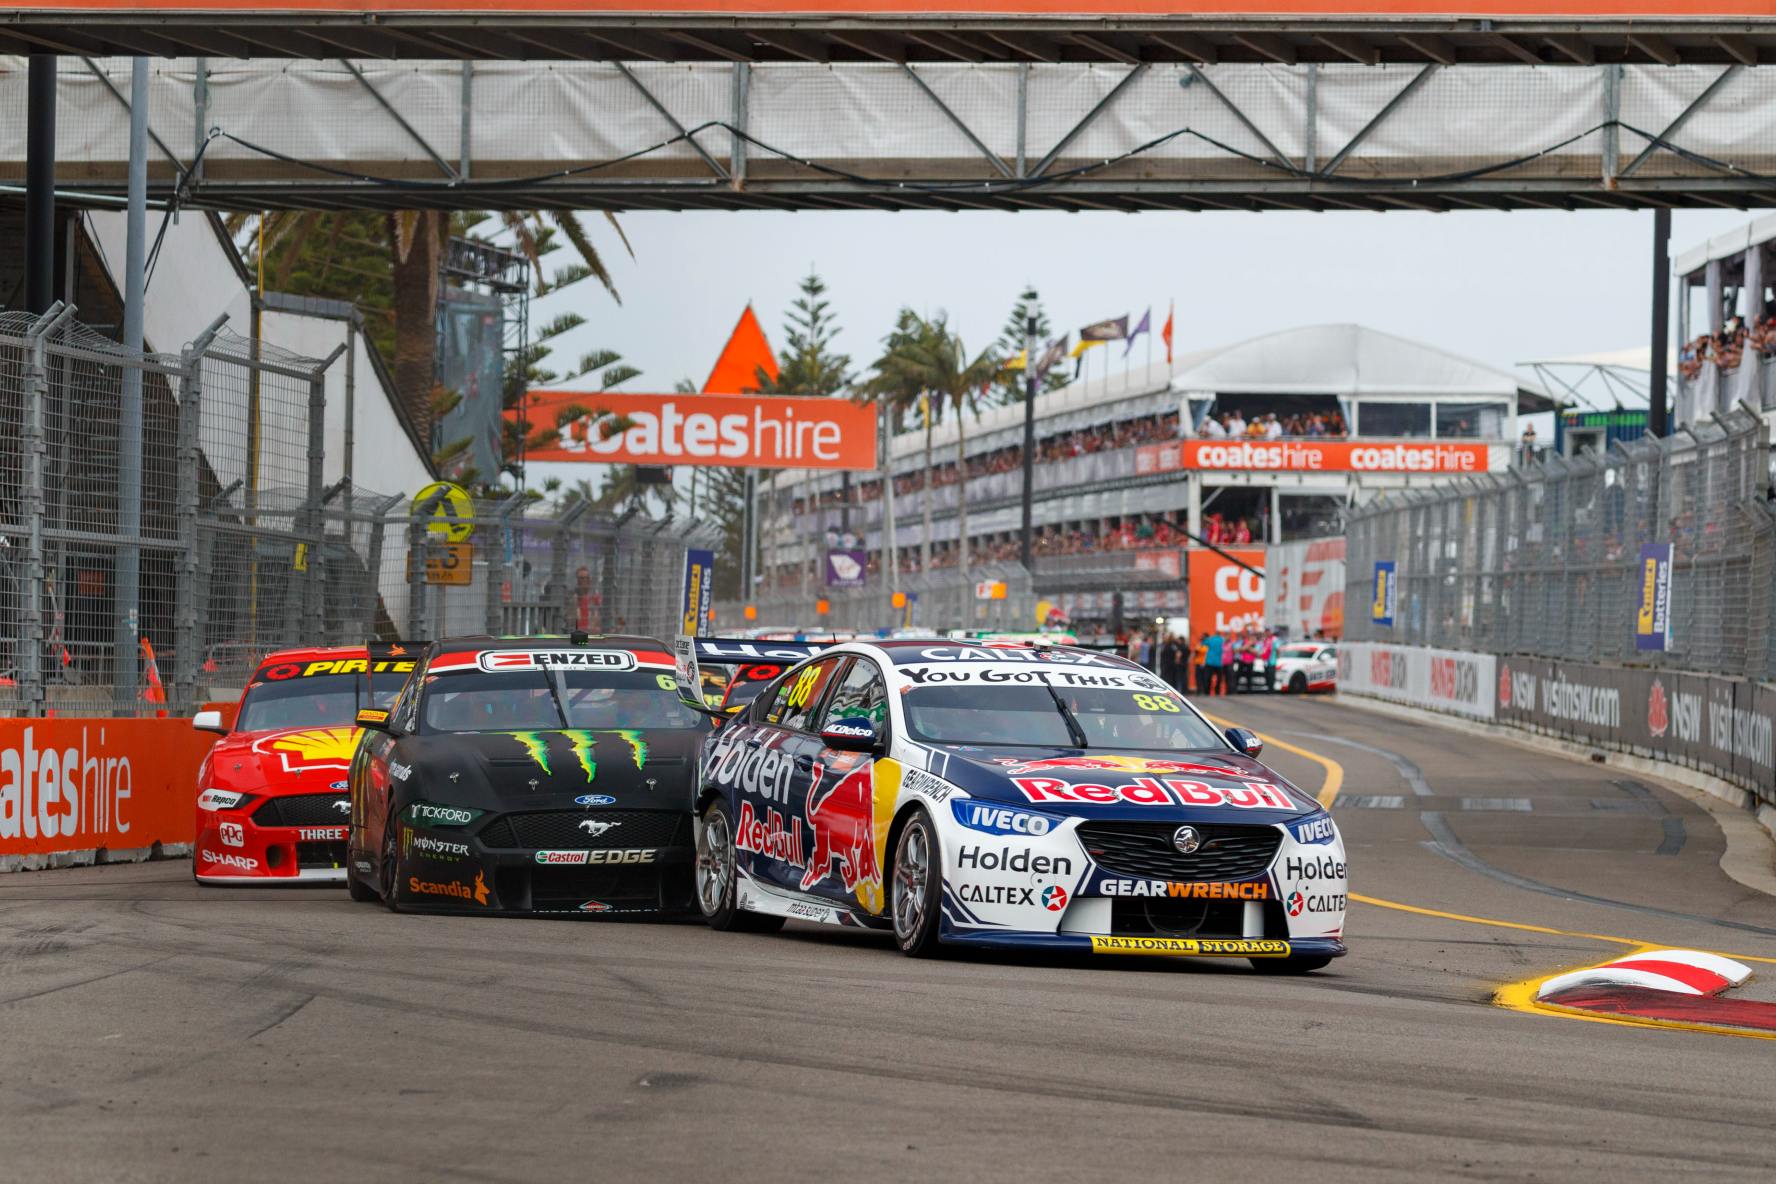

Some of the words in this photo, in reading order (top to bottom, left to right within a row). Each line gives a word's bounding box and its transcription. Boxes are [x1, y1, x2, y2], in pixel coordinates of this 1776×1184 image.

[1654, 561, 1667, 633] Batteries
[303, 660, 417, 676] PIRTE
[533, 653, 621, 665] ENZED
[788, 665, 822, 707] 88
[1512, 672, 1536, 711] NSW
[1132, 693, 1180, 713] 88
[1672, 692, 1702, 742] NSW
[702, 725, 795, 804] Holden
[903, 769, 953, 803] GEARWRENCH
[211, 795, 237, 805] Repco
[971, 806, 1049, 835] IVECO
[220, 824, 243, 844] PPG
[300, 829, 343, 840] THREE
[413, 836, 469, 857] MONSTER
[548, 851, 584, 863] Castrol
[588, 849, 657, 864] EDGE
[202, 849, 259, 870] SHARP
[958, 845, 1072, 875] Holden
[410, 877, 472, 899] Scandia
[959, 884, 1035, 906] CALTEX
[1099, 879, 1268, 900] GEARWRENCH
[1307, 894, 1347, 912] CALTE
[1096, 937, 1194, 951] NATIONAL
[1202, 940, 1285, 953] STORAGE
